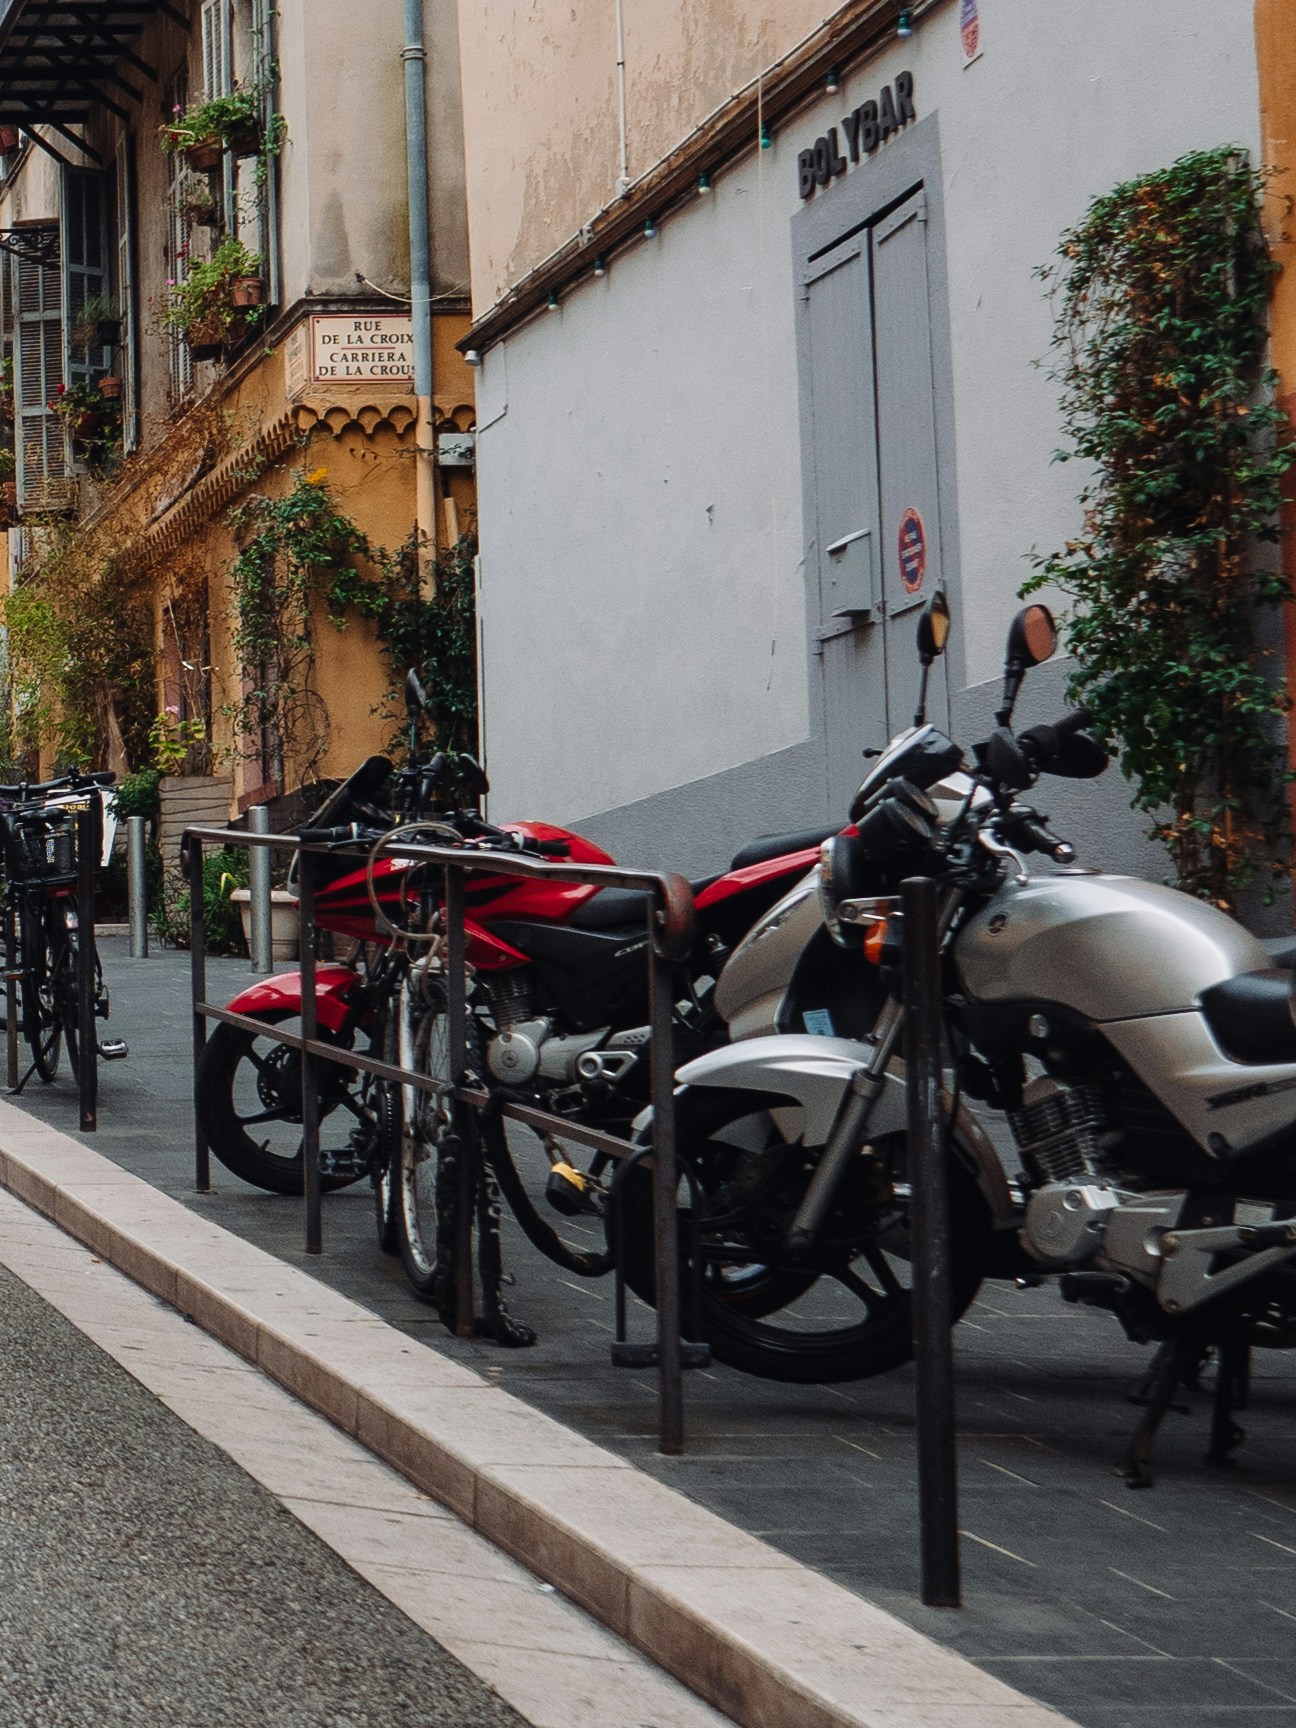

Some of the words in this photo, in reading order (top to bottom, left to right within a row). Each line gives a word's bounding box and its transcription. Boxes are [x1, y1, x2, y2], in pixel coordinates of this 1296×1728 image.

[798, 70, 916, 200] BOLYBAR
[353, 321, 382, 332] RUE
[322, 335, 339, 345] DE
[347, 334, 364, 344] LA
[370, 333, 414, 344] CROIX
[330, 352, 406, 363] CARRIERA
[319, 366, 337, 376] DE
[345, 365, 364, 376] LA
